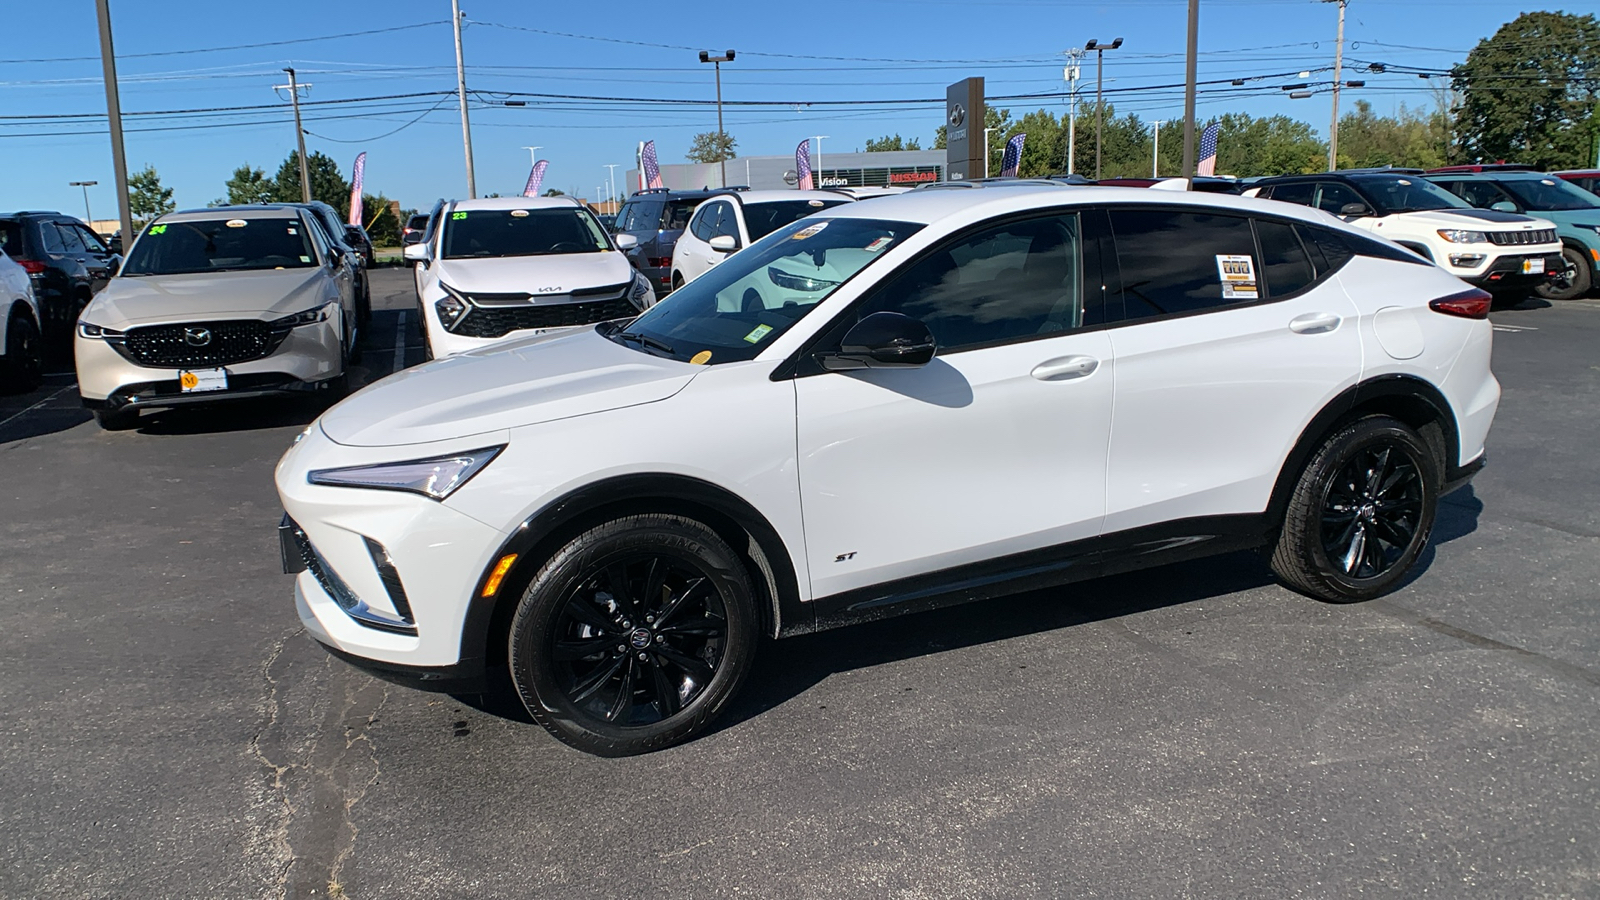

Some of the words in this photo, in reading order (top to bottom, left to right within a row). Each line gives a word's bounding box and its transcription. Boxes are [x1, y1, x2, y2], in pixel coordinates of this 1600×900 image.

[820, 177, 838, 186] Vision
[890, 172, 937, 182] NISSAN
[452, 212, 468, 220] 23
[149, 225, 167, 236] 24
[184, 376, 195, 385] M
[833, 551, 857, 563] ST
